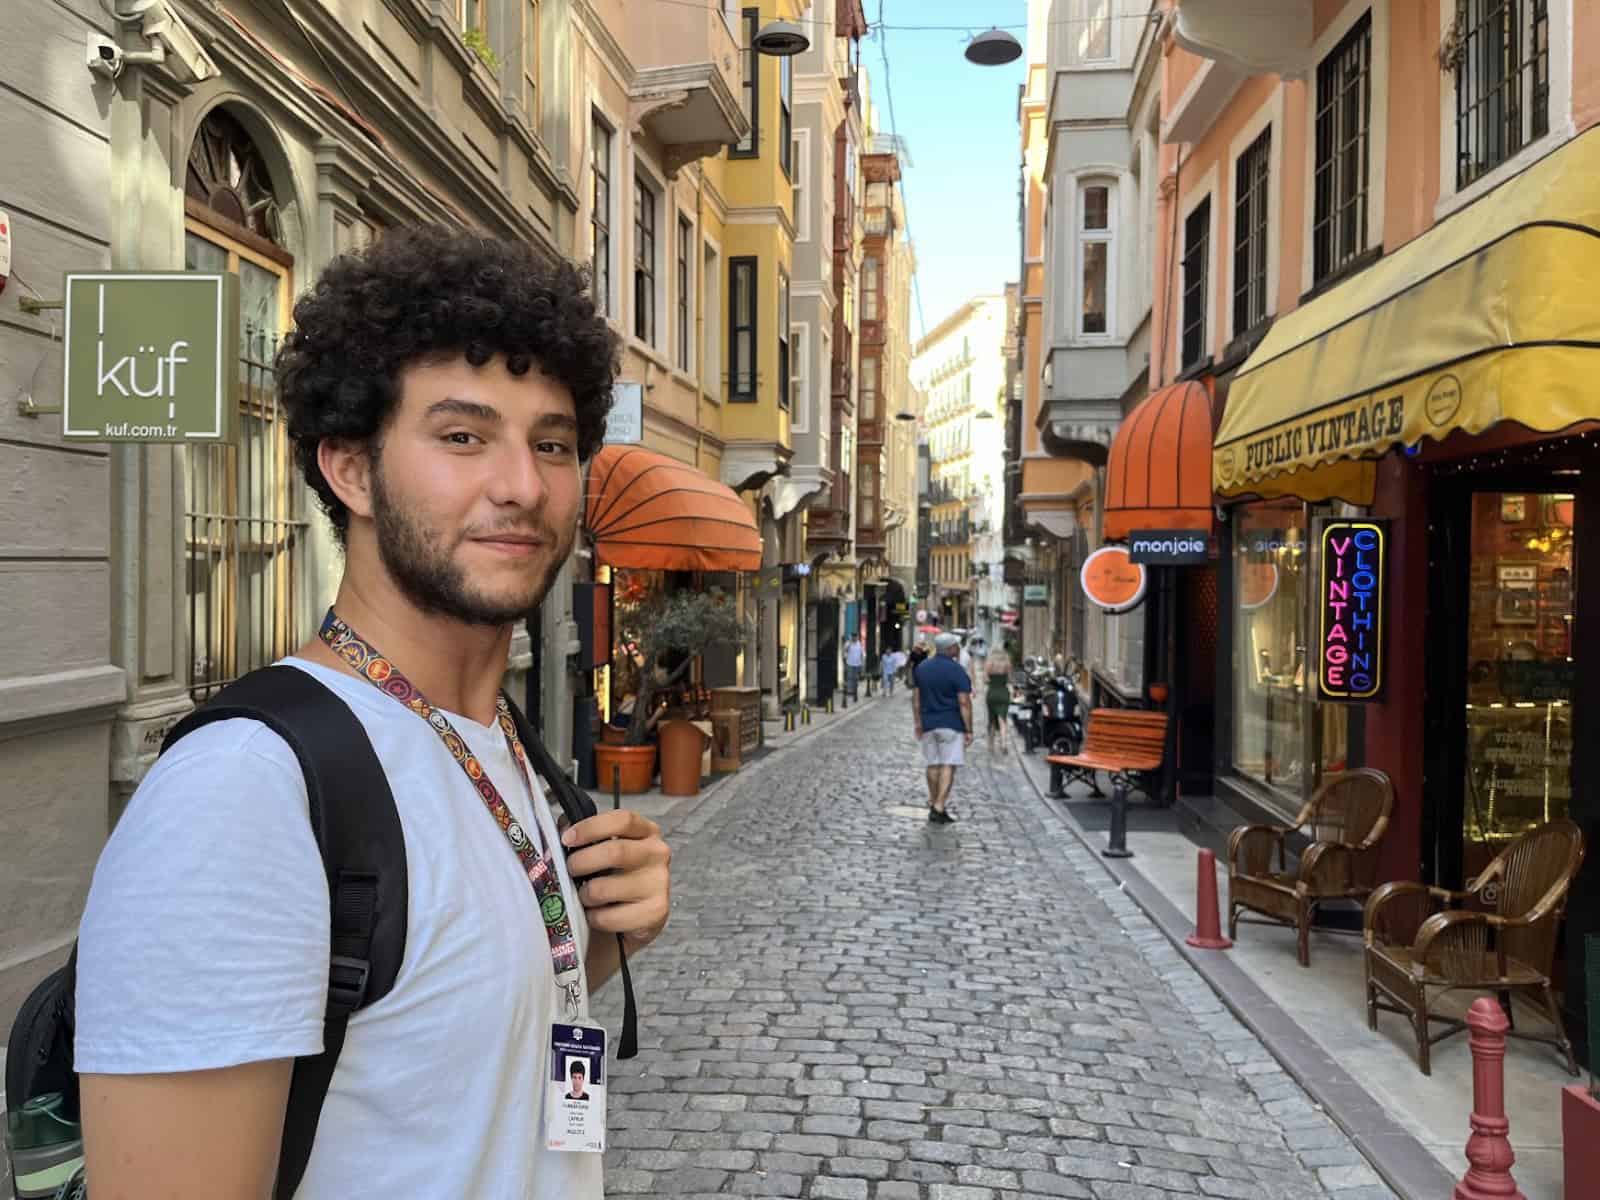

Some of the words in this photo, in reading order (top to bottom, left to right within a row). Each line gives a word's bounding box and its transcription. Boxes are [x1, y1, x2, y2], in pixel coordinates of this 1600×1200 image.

[97, 340, 189, 418] küf
[1245, 427, 1301, 471] PUBLIC
[1306, 395, 1404, 455] VINTAGE
[1133, 536, 1205, 556] monjoie
[1325, 536, 1352, 686] VINTAGE
[1350, 530, 1377, 691] CLOTHING
